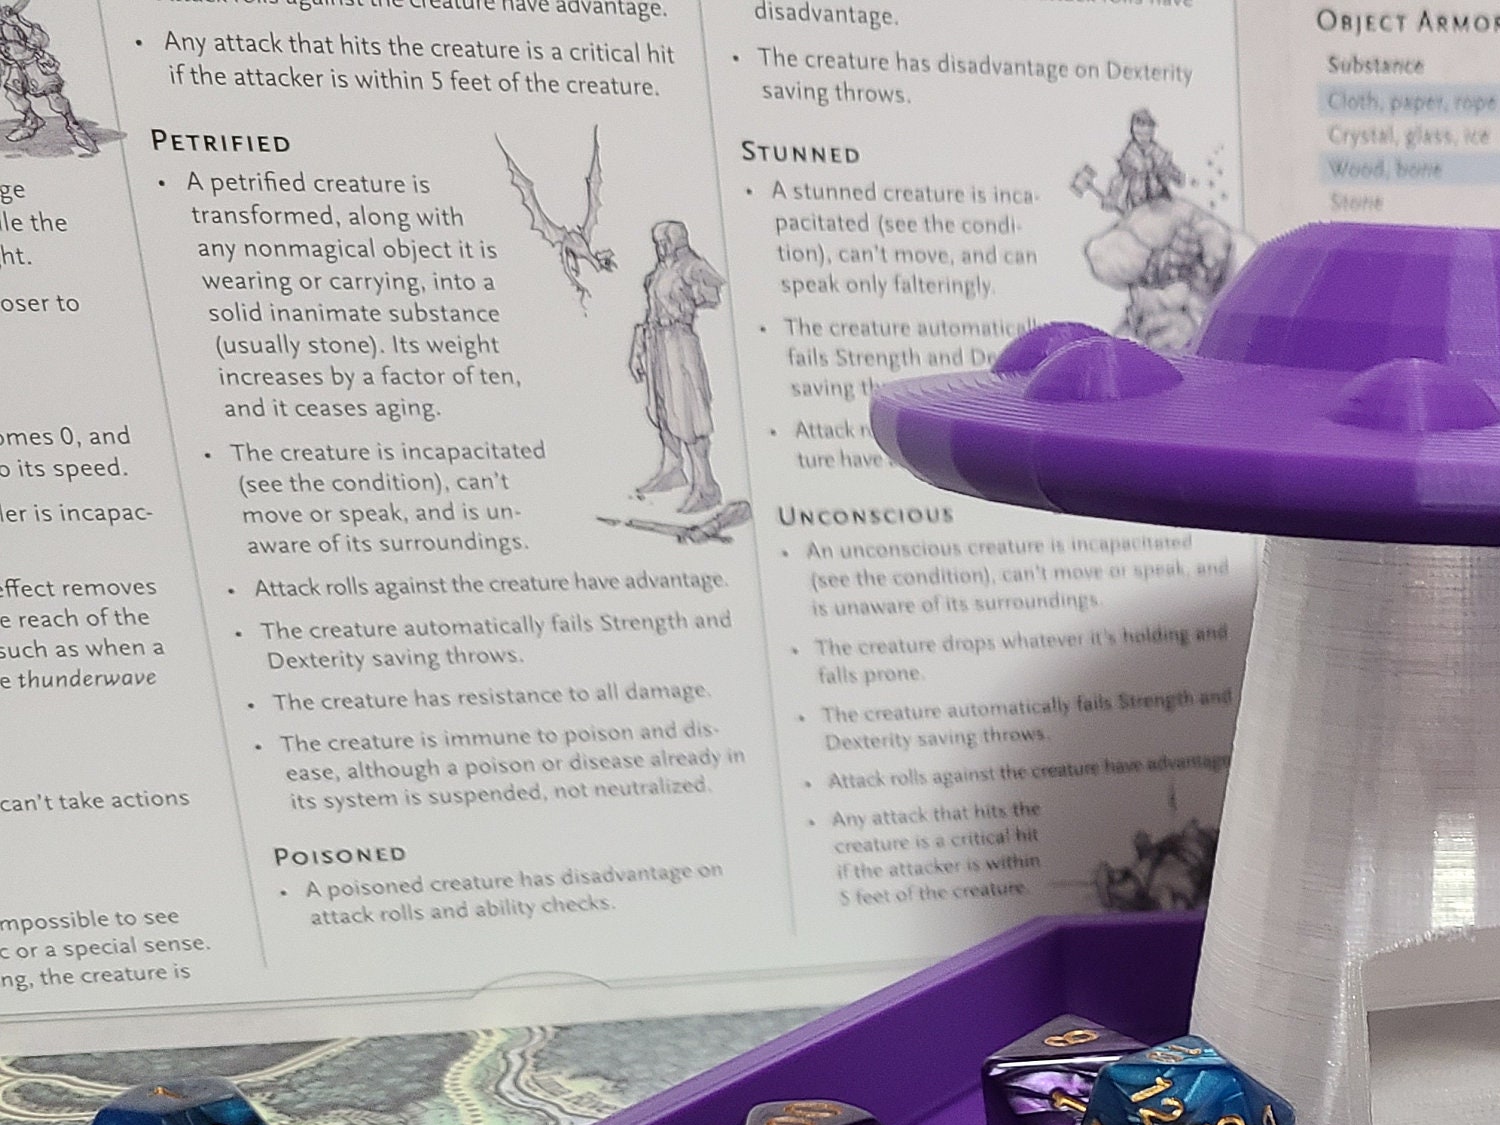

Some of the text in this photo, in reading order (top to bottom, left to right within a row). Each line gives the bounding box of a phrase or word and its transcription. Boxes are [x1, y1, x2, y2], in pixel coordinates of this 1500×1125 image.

[754, 0, 899, 32] disadvantage.
[1316, 6, 1407, 37] OBJECT
[164, 29, 675, 65] Any attack that hits the creature is a critical hit
[168, 62, 660, 97] if the attacker is within 5 feet of the creature.
[756, 44, 1193, 89] The creature has disadvantage on Dexterity
[150, 128, 291, 154] PETRIFIED
[741, 139, 860, 165] STUNNED
[186, 170, 431, 198] A petrified creature is
[191, 202, 464, 233] transformed, along with
[197, 236, 498, 265] any nonmagical object it is
[201, 270, 496, 298] wearing or carrying, into a
[208, 300, 500, 324] solid inanimate substance
[215, 333, 500, 361] (usually stone). Its weight
[218, 363, 522, 392] increases by a factor of ten,
[224, 396, 442, 423] and it ceases aging.
[16, 455, 129, 484] its speed.
[33, 502, 153, 528] is incapac-
[62, 581, 158, 597] removes
[18, 605, 150, 629] reach of the
[55, 636, 166, 659] as when a
[17, 667, 157, 690] thunderwave
[58, 789, 105, 812] take
[111, 789, 191, 810] actions
[273, 846, 406, 867] POISONED
[14, 935, 211, 962] or a special sense.
[38, 962, 192, 987] the creature is
